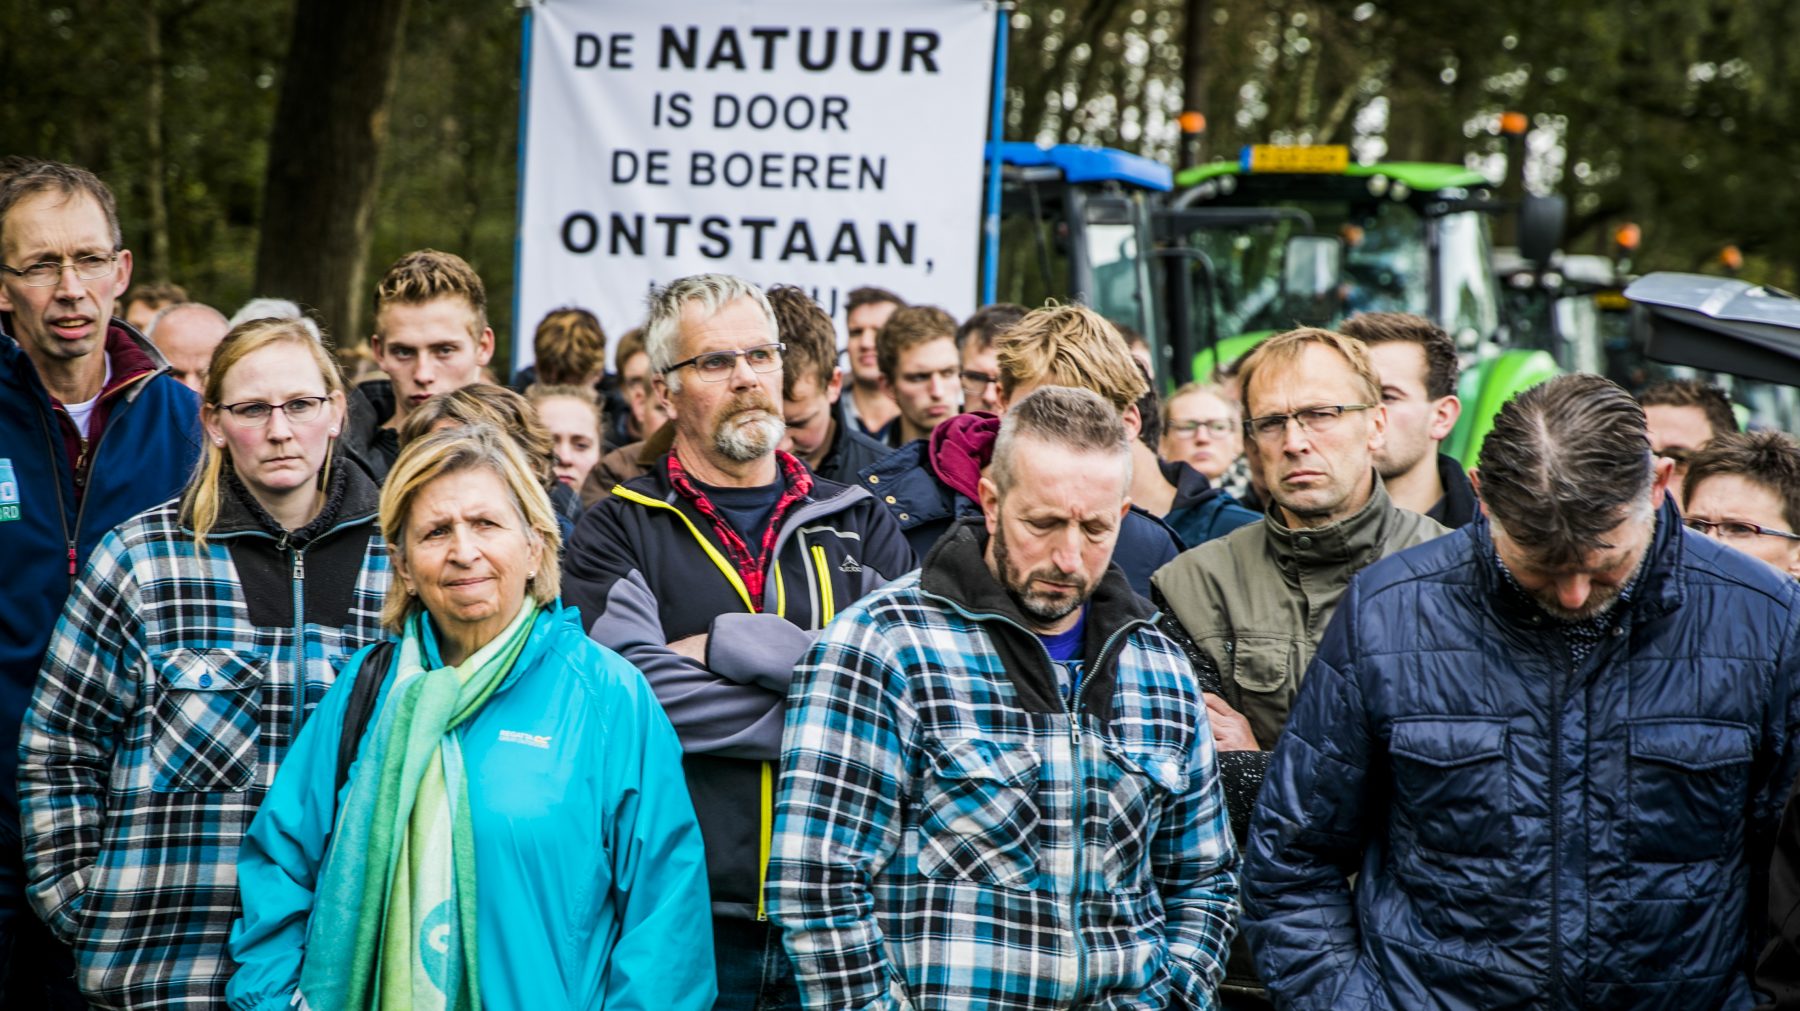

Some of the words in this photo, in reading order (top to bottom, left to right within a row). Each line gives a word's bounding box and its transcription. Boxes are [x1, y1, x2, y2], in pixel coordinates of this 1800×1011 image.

[574, 32, 635, 70] DE
[657, 25, 942, 74] NATUUR
[652, 92, 693, 129] IS
[712, 93, 850, 131] DOOR
[611, 149, 670, 186] DE
[689, 151, 886, 191] BOEREN
[560, 211, 934, 273] ONTSTAAN,
